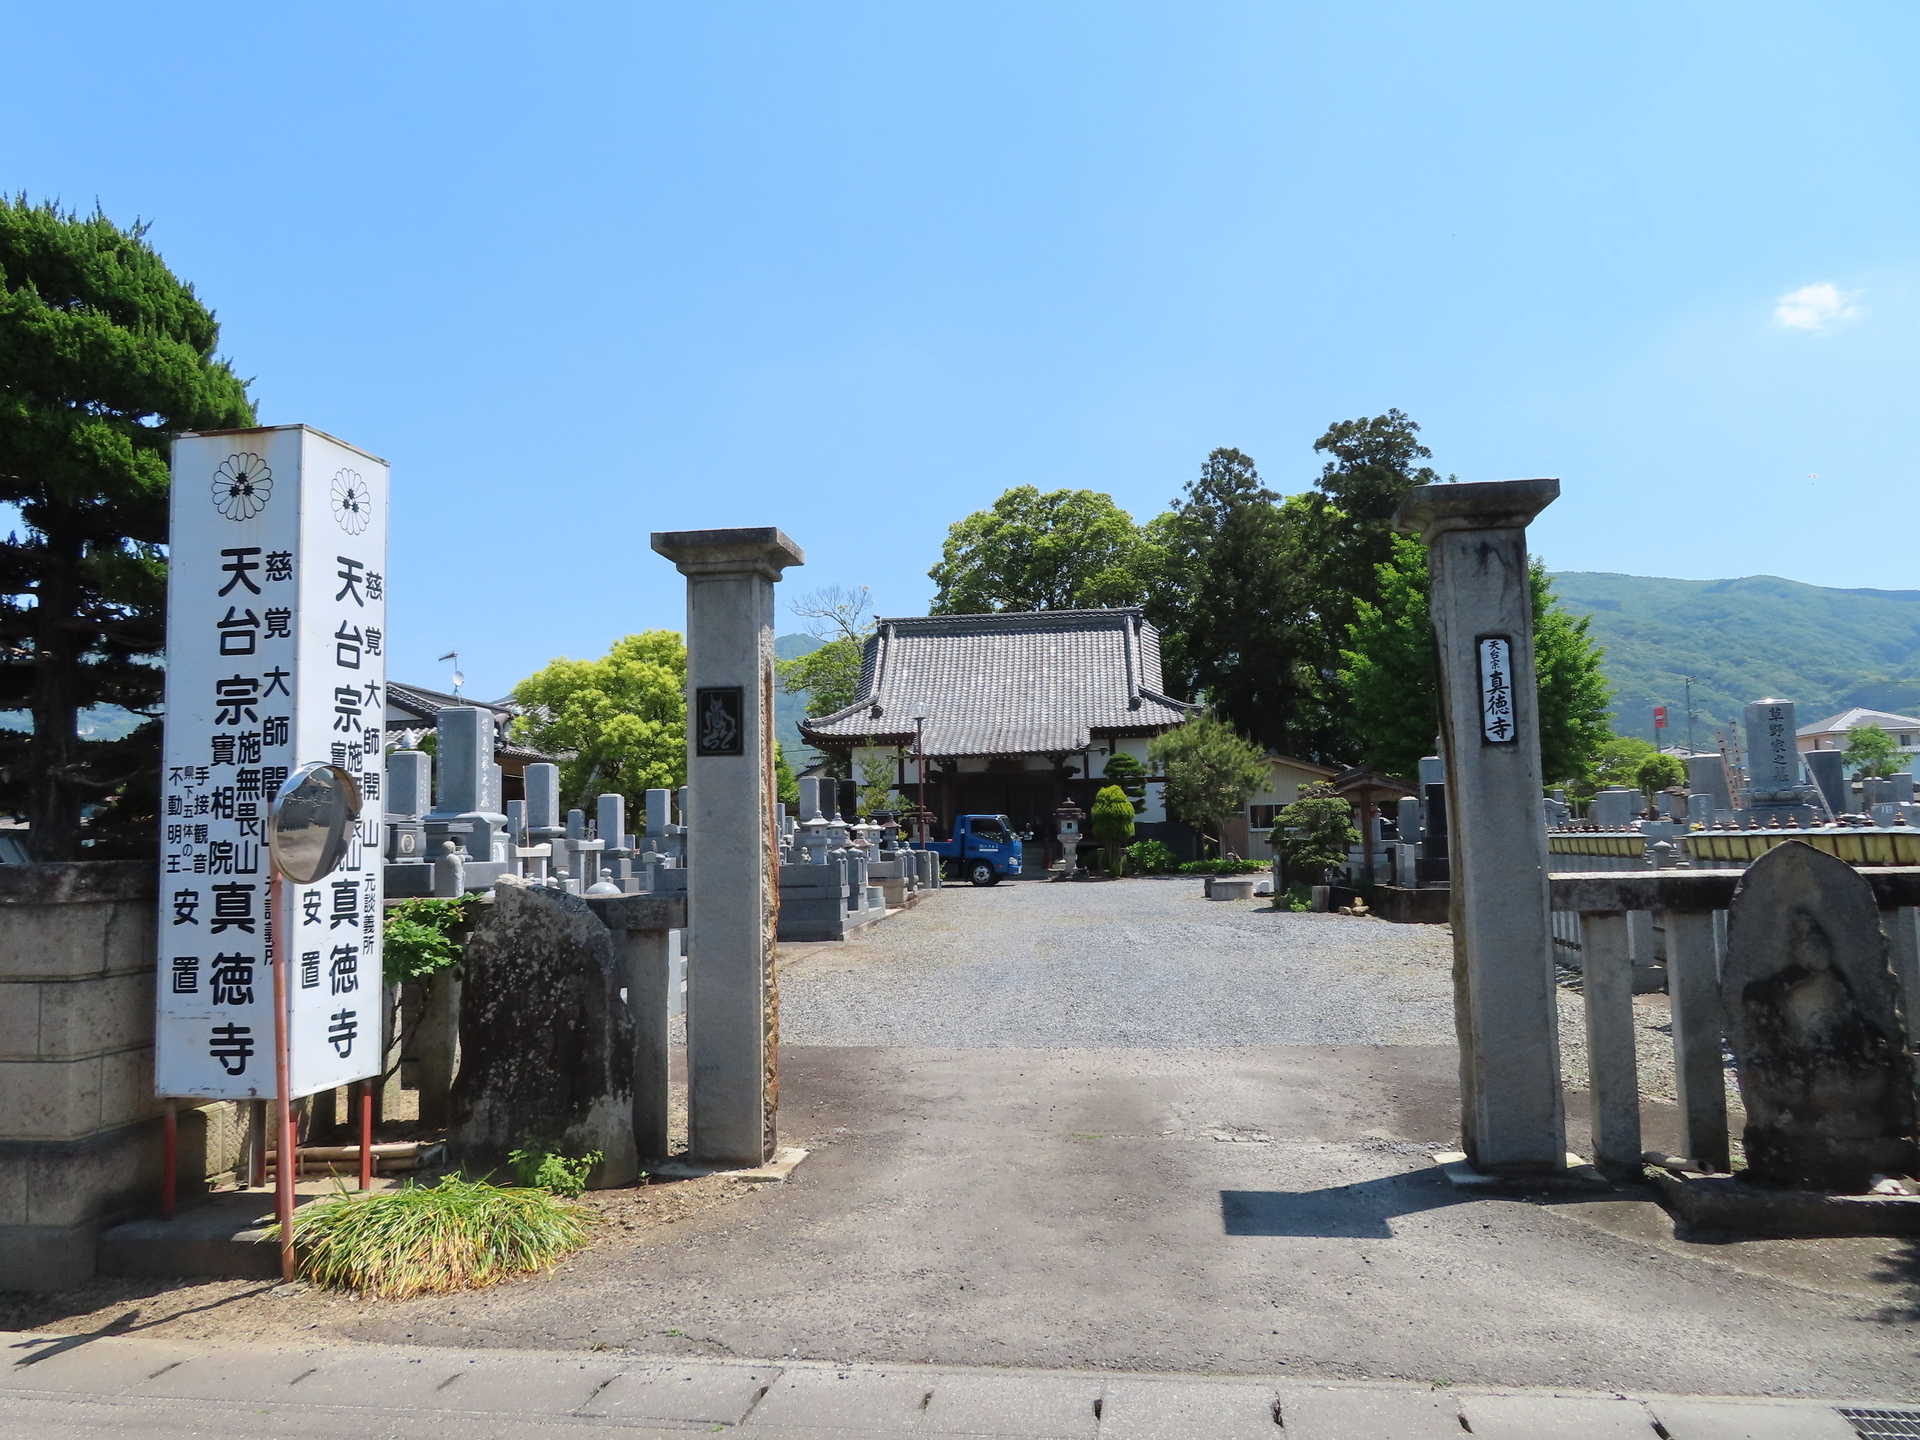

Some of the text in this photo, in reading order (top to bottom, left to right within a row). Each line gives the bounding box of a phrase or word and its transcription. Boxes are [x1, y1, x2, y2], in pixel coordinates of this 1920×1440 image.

[214, 547, 262, 725] 天台宗
[333, 555, 364, 733] 天台宗
[362, 570, 383, 848] 慈覚大師開山
[166, 766, 183, 874] 不動明王
[182, 766, 194, 871] 県下五体の一
[193, 766, 210, 873] 手接観音
[234, 730, 262, 875] 施無畏山
[172, 888, 199, 994] 安置
[301, 888, 322, 990] 安置
[328, 878, 360, 1059] 真徳寺
[362, 873, 376, 955] 元談義所
[209, 881, 255, 1076] 真徳寺
